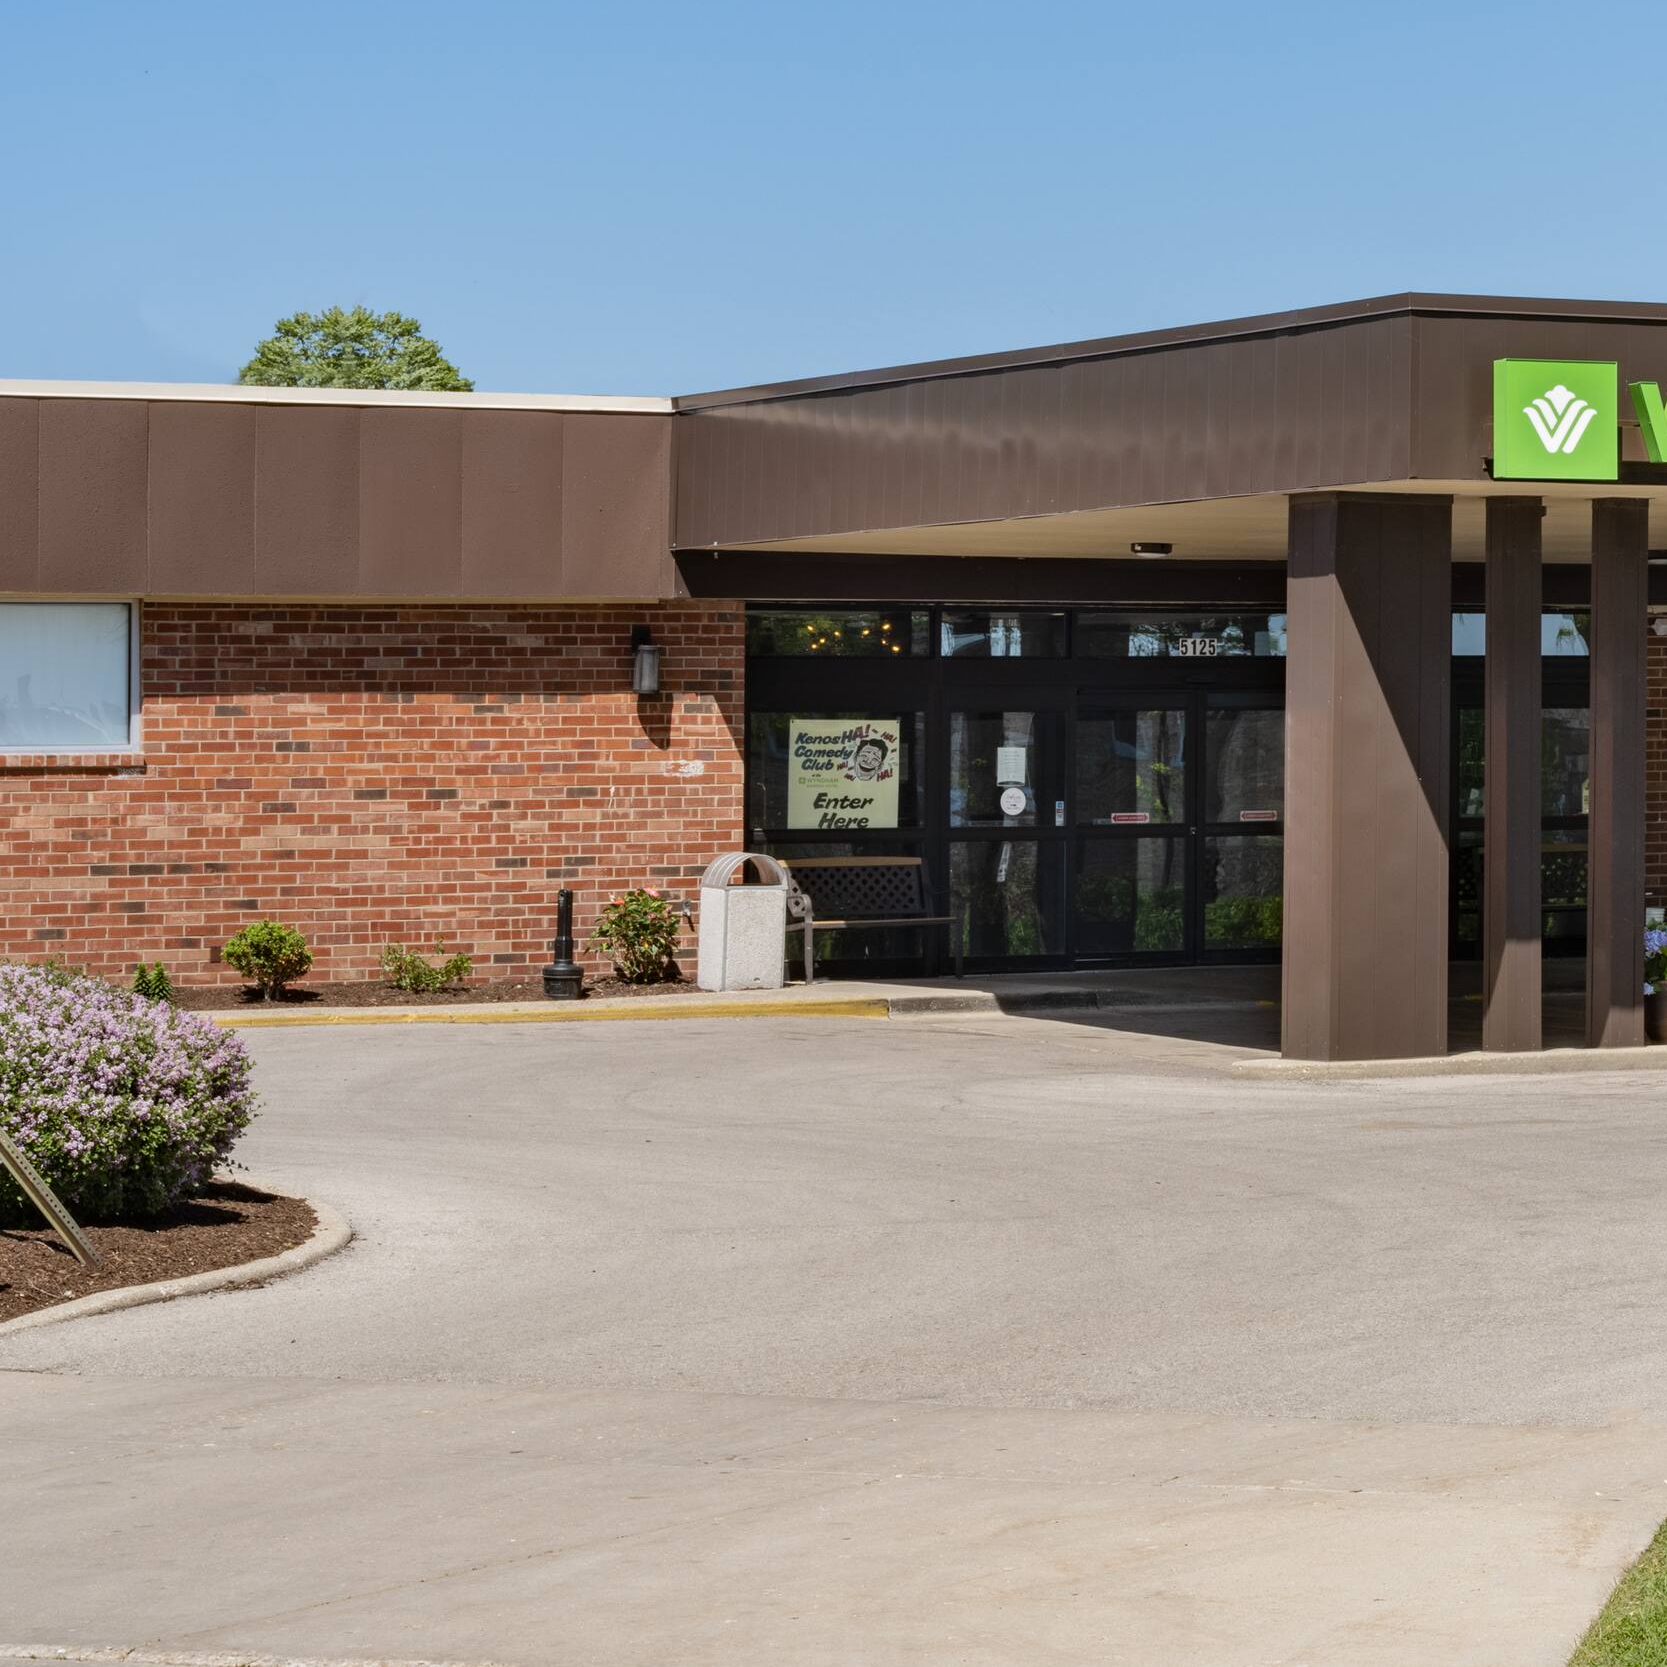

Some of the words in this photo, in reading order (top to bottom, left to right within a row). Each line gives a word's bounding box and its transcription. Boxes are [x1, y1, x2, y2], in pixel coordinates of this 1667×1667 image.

[1181, 639, 1216, 655] 5125
[794, 745, 854, 760] Comedy
[801, 758, 834, 771] Club
[876, 768, 893, 782] HA!
[813, 792, 874, 809] Enter
[818, 812, 869, 829] Here
